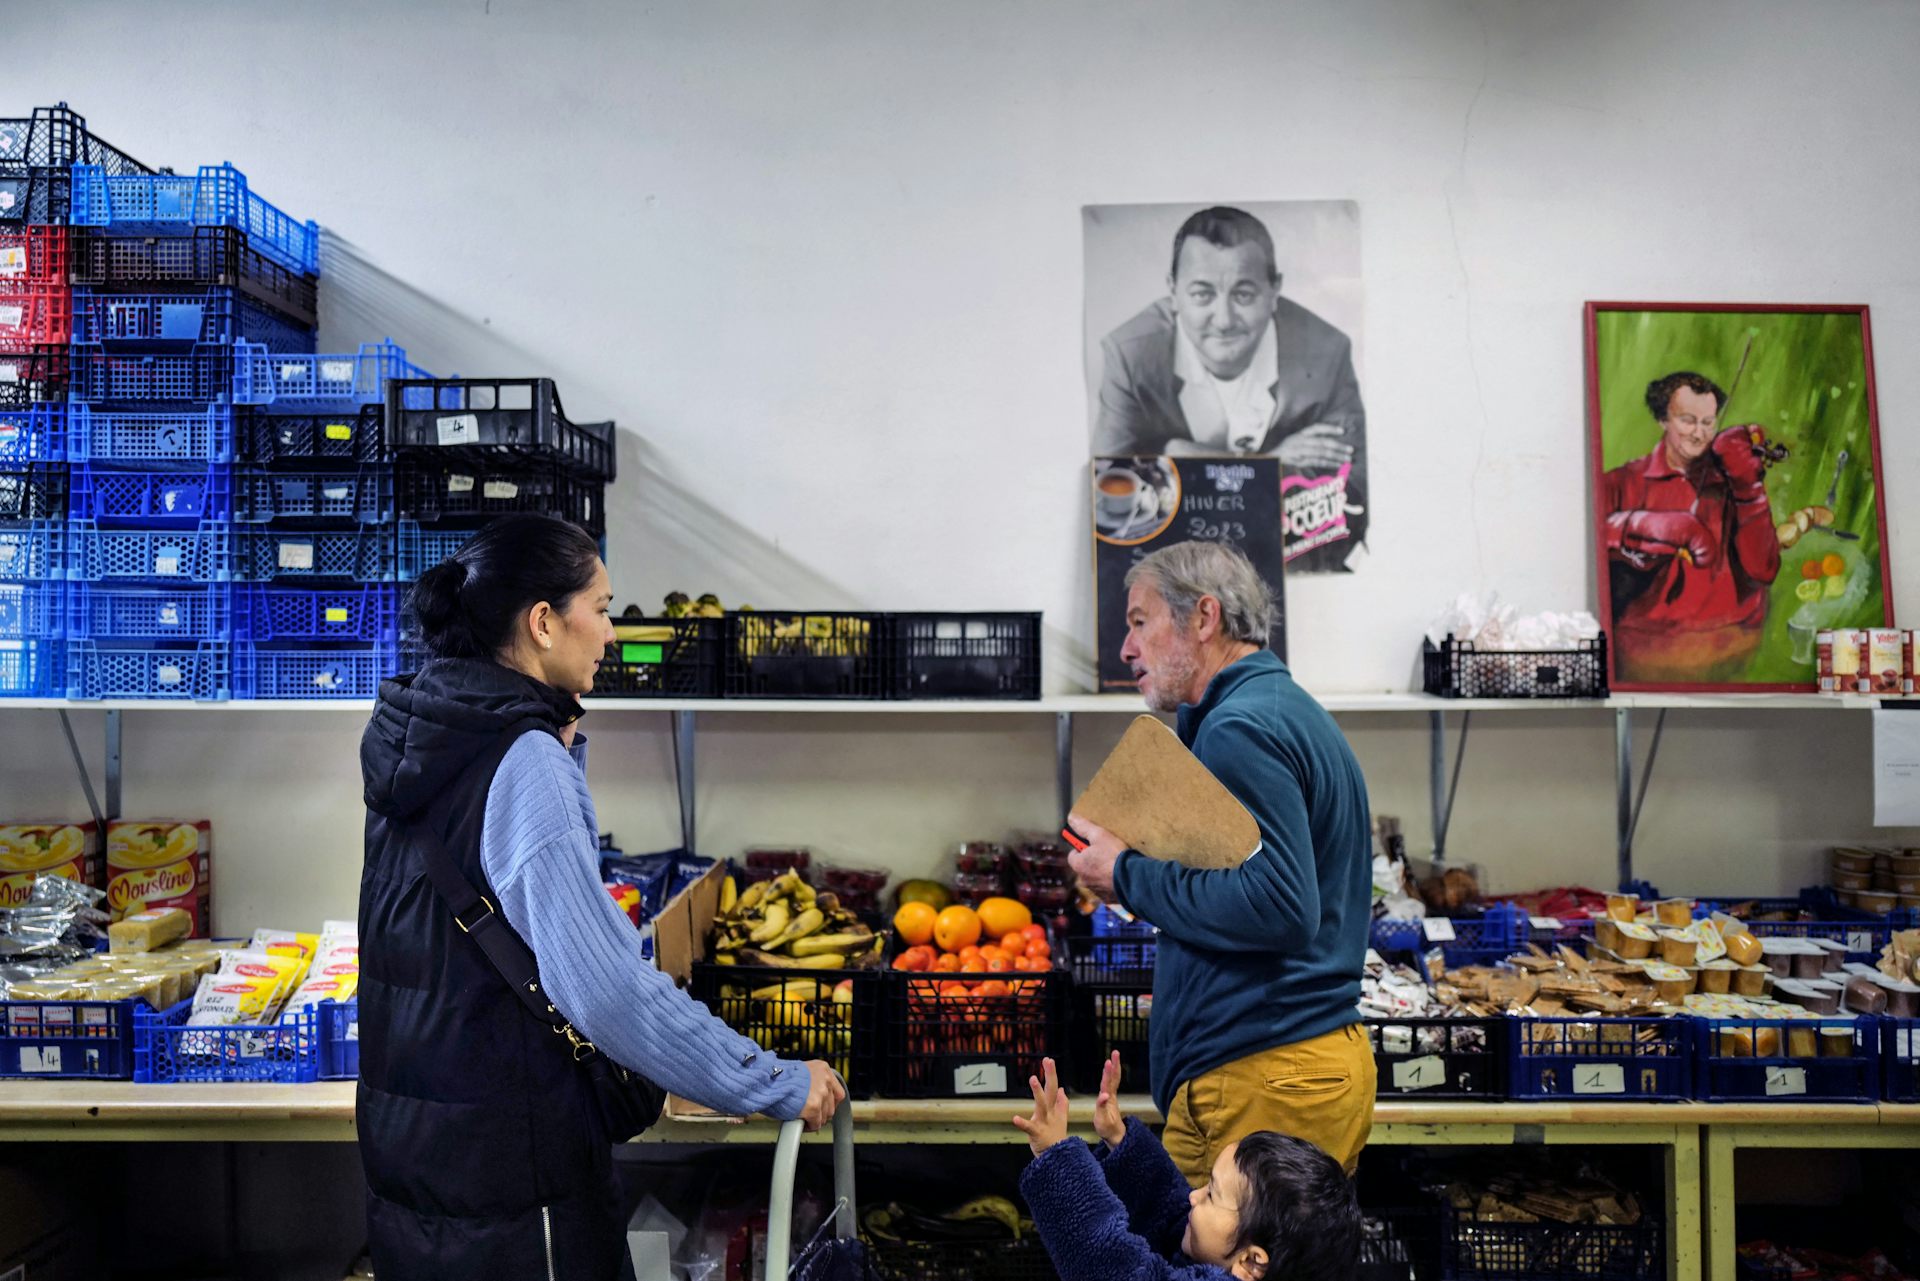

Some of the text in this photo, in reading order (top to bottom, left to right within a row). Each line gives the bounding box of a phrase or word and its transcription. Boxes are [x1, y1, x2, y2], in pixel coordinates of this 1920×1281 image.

[452, 419, 464, 432] 4
[1184, 494, 1245, 512] HIVER
[1189, 517, 1246, 543] 2023
[111, 869, 190, 905] Mousline
[47, 1052, 58, 1066] 4
[965, 1070, 987, 1086] 1
[1408, 1066, 1422, 1082] 1
[1584, 1071, 1605, 1087] 1
[1780, 1073, 1788, 1086] 1
